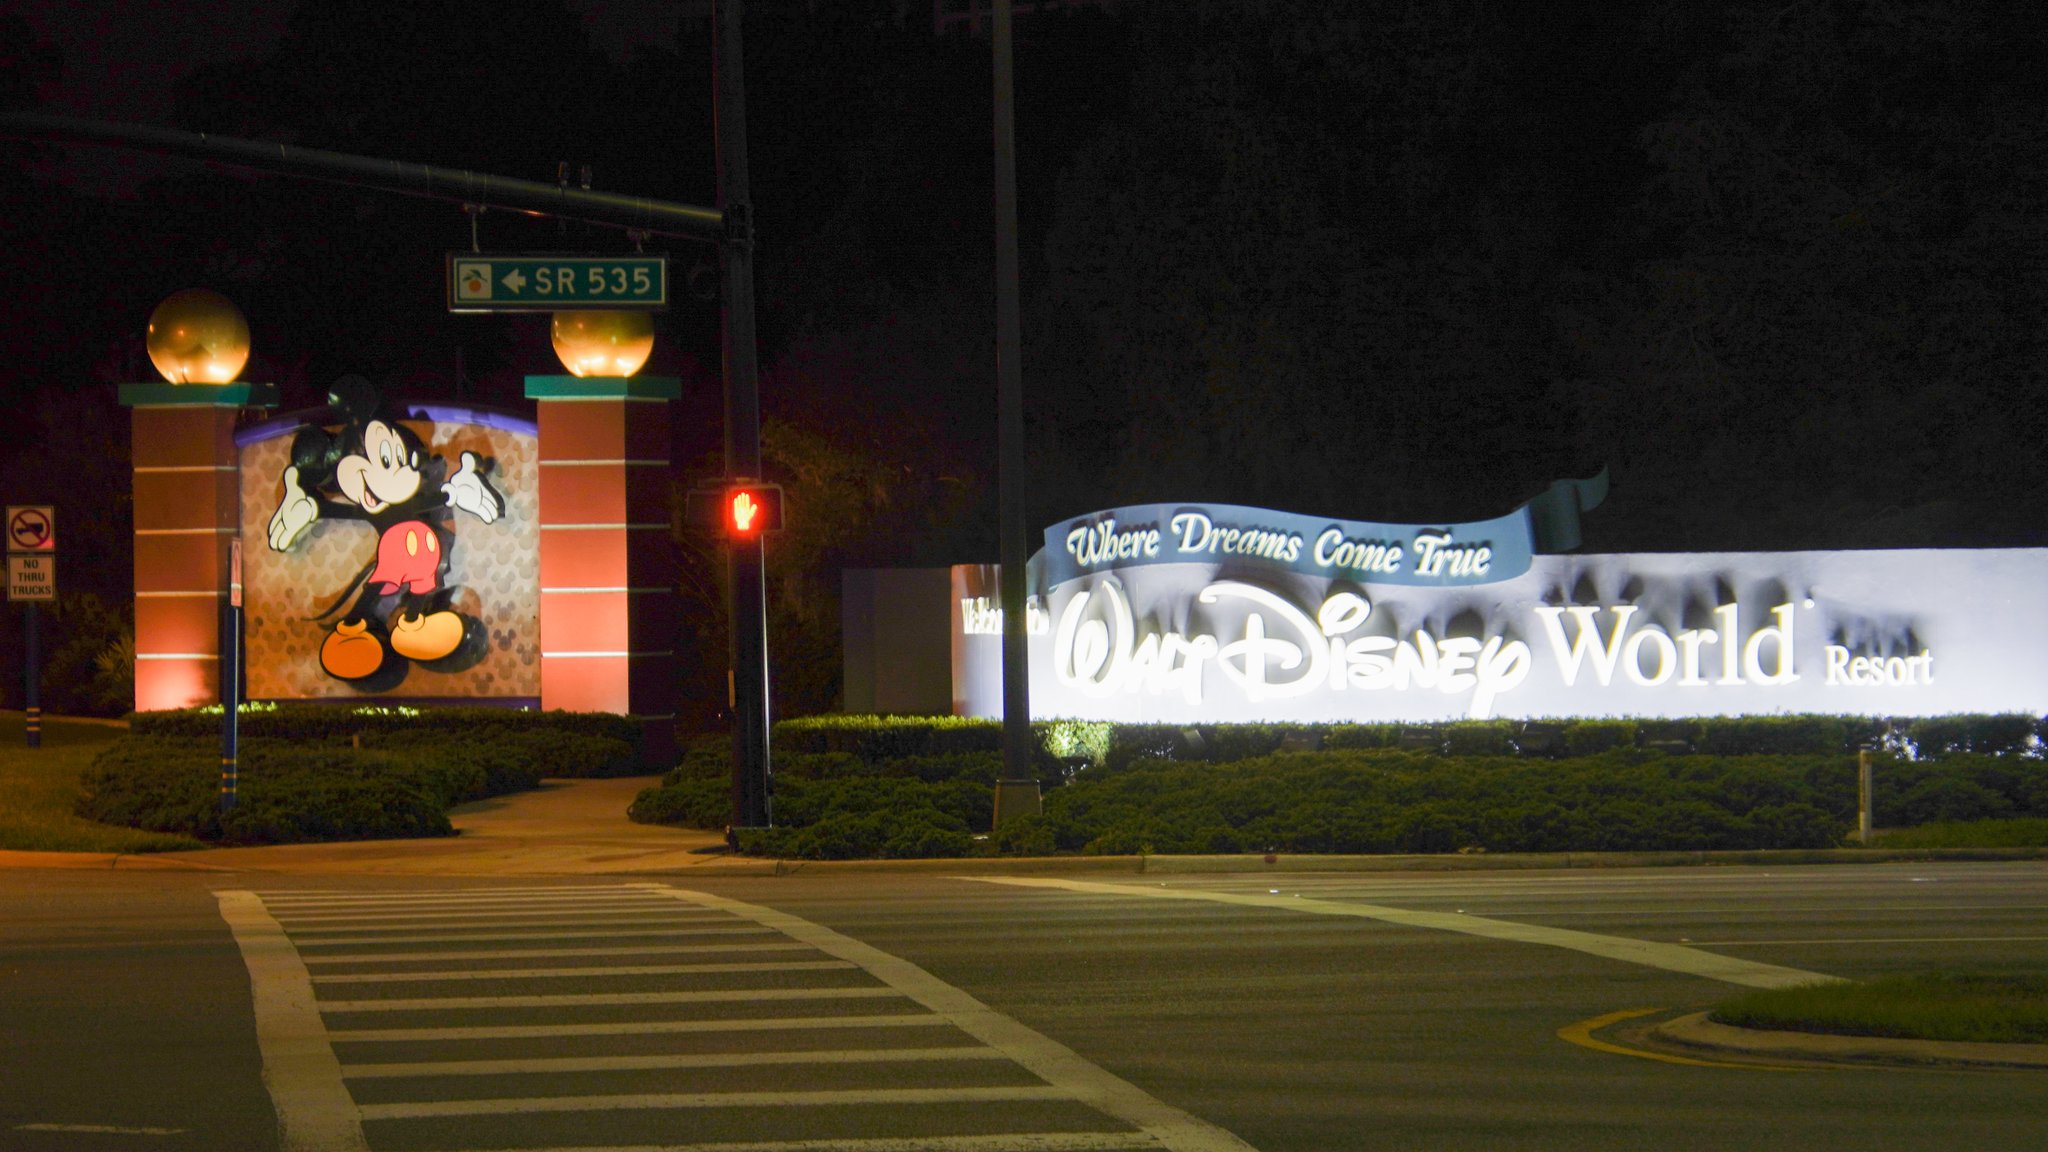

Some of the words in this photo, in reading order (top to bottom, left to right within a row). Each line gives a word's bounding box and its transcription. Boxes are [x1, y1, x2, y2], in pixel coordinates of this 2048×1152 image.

[535, 267, 576, 295] SR
[588, 267, 651, 295] 535
[1066, 519, 1160, 565] Where
[1170, 512, 1303, 564] Dreams
[1313, 528, 1404, 574] Come
[1412, 533, 1493, 578] True
[23, 559, 39, 569] NO
[17, 572, 45, 582] THRU
[12, 585, 52, 595] TRUCKS
[1533, 602, 1800, 687] World
[1824, 645, 1935, 686] Resort
